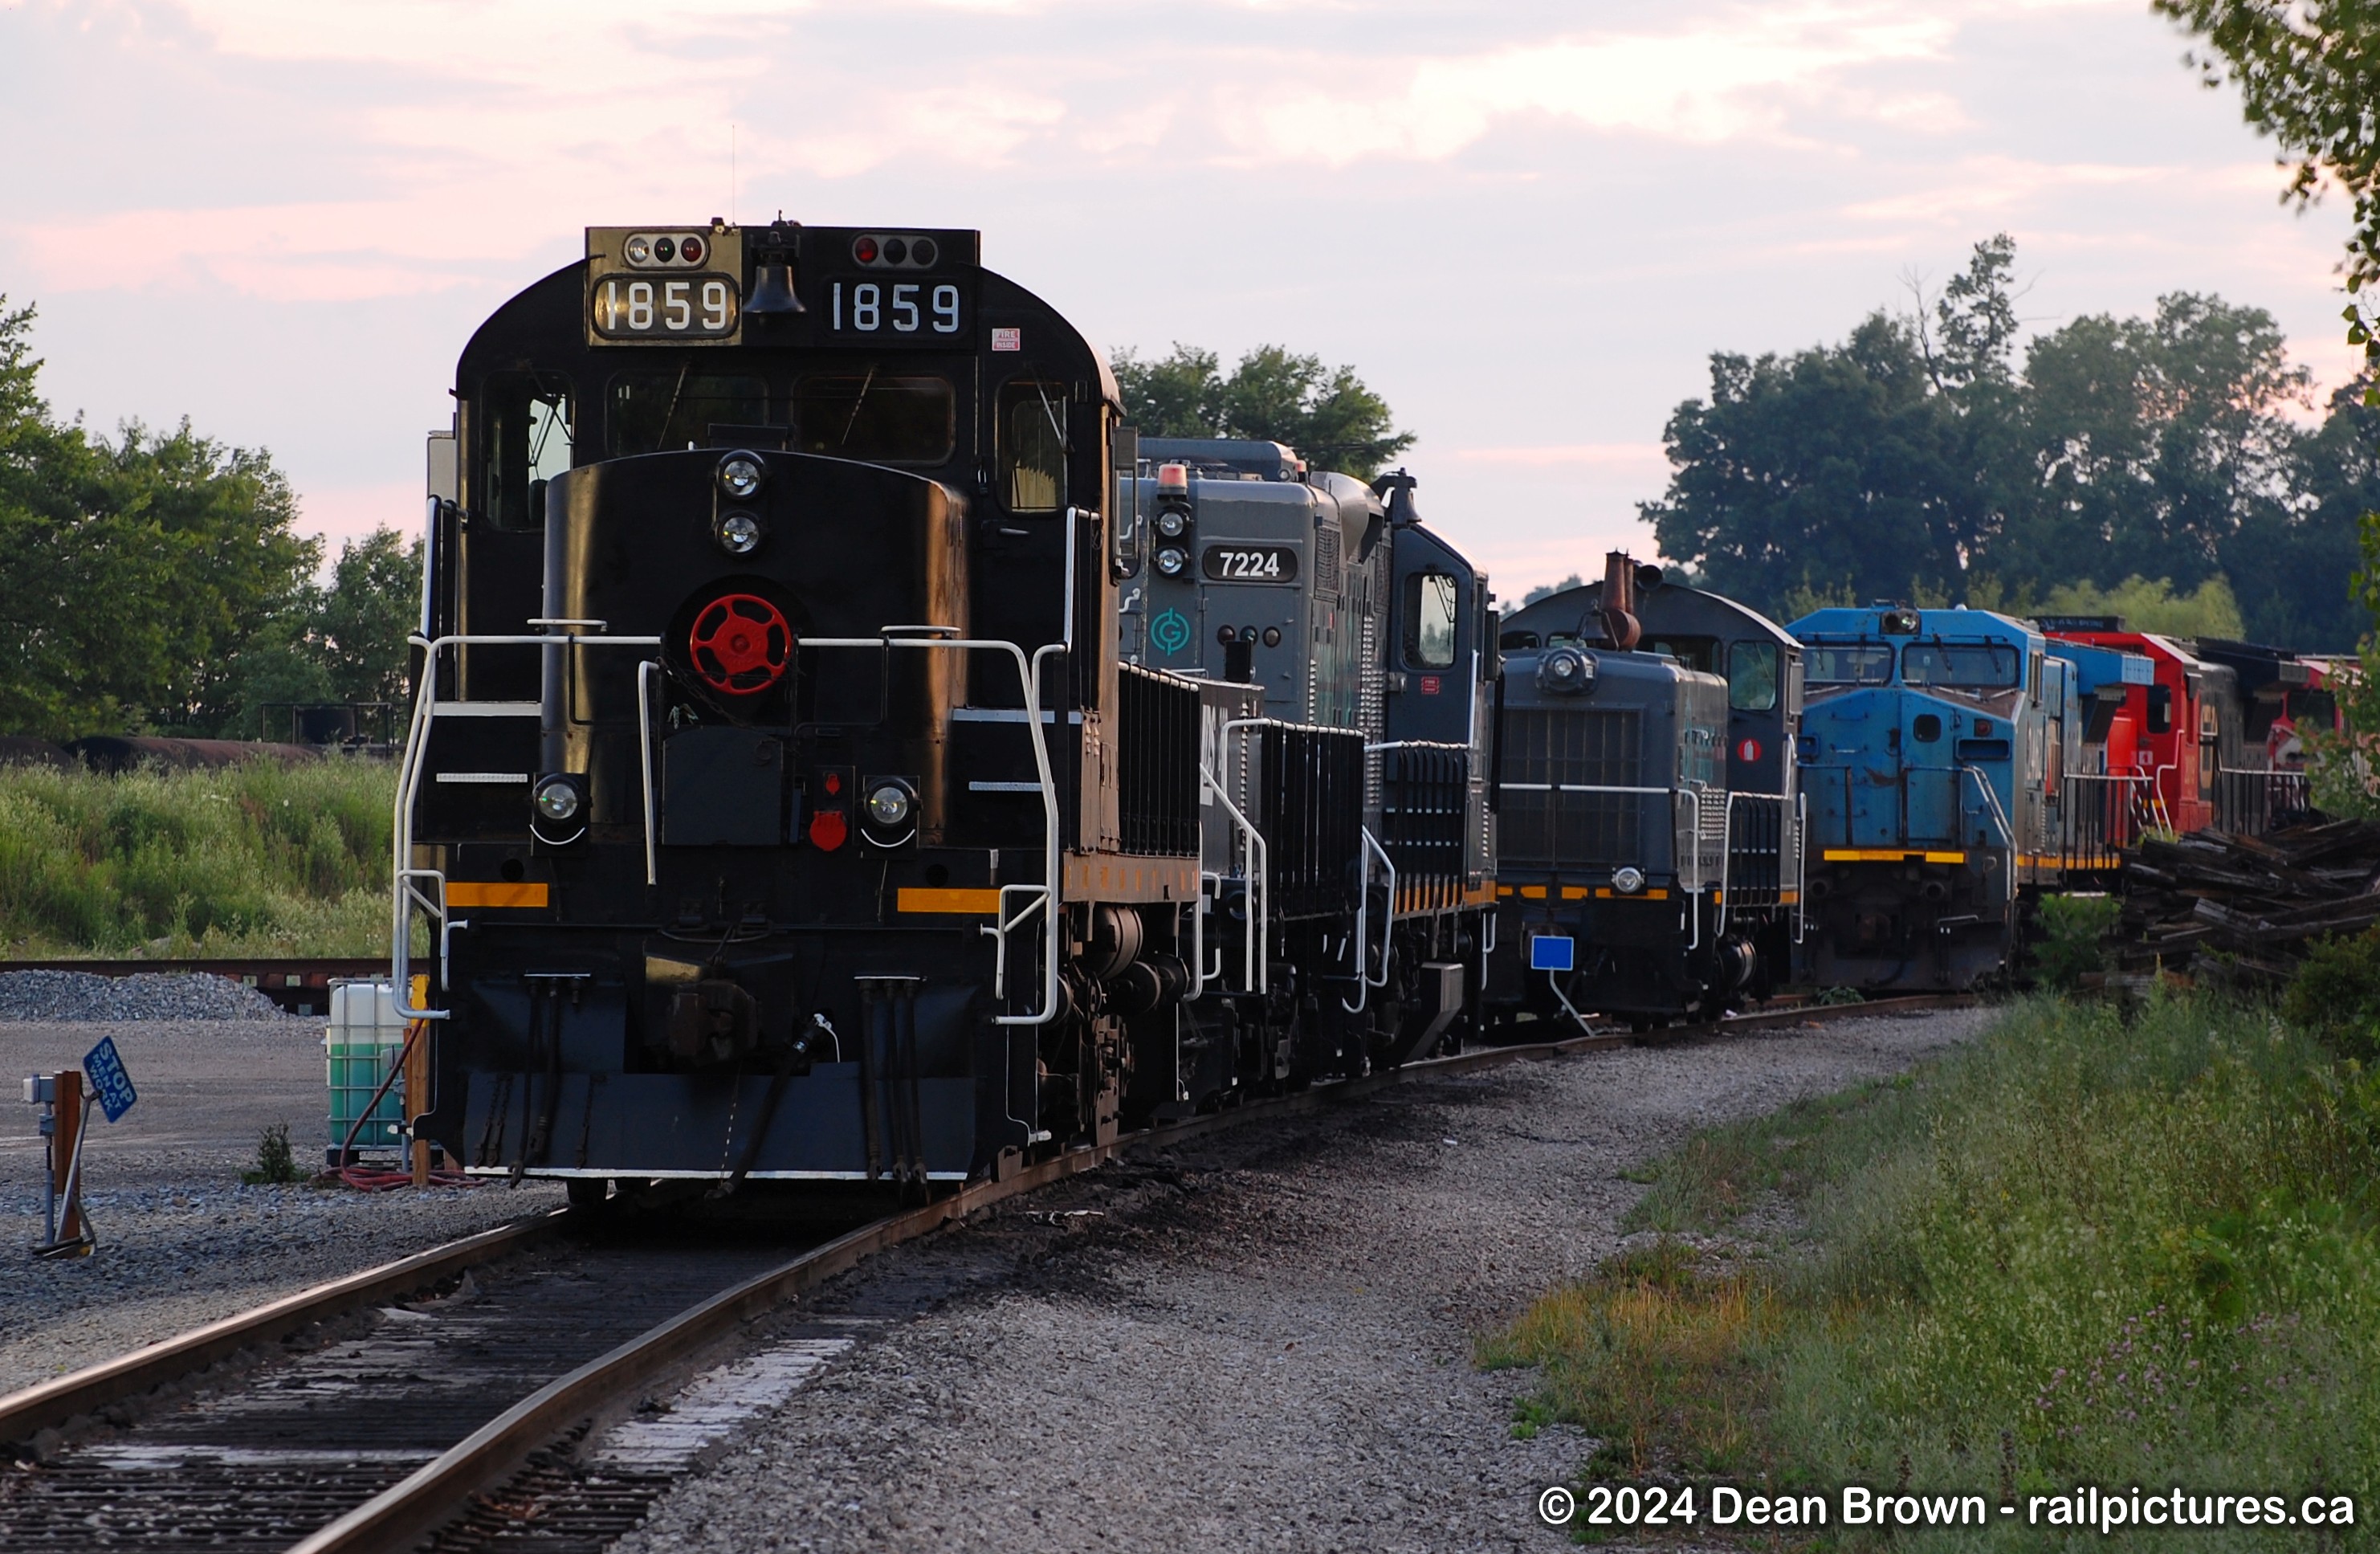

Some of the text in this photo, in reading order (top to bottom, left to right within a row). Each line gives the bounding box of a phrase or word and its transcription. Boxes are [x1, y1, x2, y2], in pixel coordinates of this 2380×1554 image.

[608, 282, 726, 330] 1859
[833, 283, 959, 332] 1859
[1220, 553, 1280, 577] 7224
[89, 1064, 113, 1111] WORK
[93, 1053, 122, 1108] MEN AT
[99, 1042, 133, 1103] STOP
